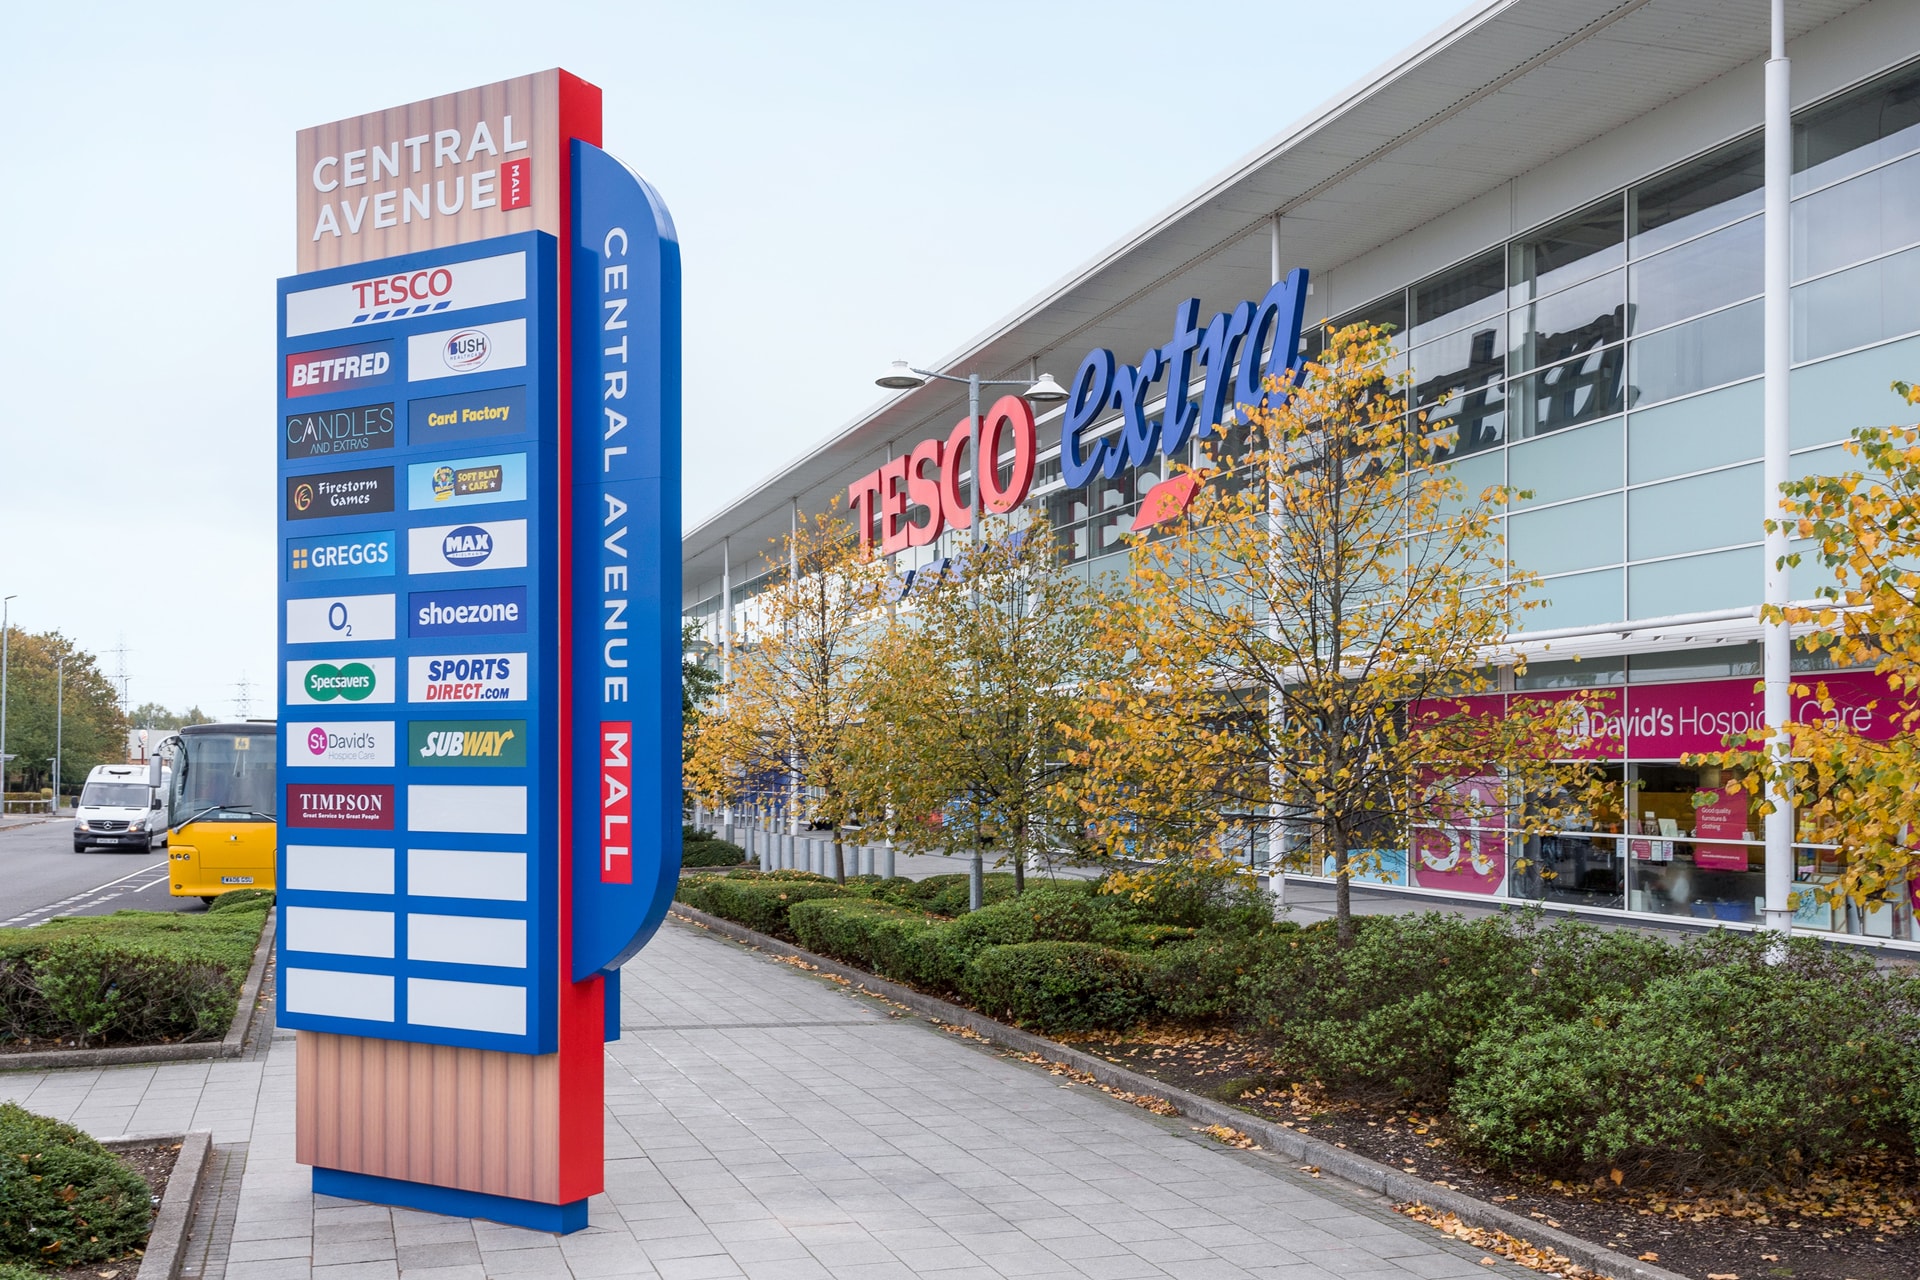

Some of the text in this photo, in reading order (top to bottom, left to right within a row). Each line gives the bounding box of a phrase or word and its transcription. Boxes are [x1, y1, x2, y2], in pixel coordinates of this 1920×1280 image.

[312, 115, 528, 193] CENTRAL
[511, 165, 521, 206] MALL
[312, 170, 496, 241] AVENUE
[352, 268, 453, 309] TESCO
[450, 337, 485, 355] BUSH
[292, 351, 390, 387] BETFRED
[287, 407, 394, 444] CANDLES
[428, 405, 510, 427] Card Factory
[848, 267, 1309, 564] TESCO extra
[310, 437, 369, 454] AND EXTRAS
[457, 468, 499, 483] SOFT PLAY
[468, 480, 489, 491] CAFE
[318, 480, 378, 495] Firestorm
[330, 494, 370, 507] Games
[311, 542, 389, 568] GREGGS
[446, 534, 489, 553] MAX
[604, 226, 629, 872] CENTRAL AVENUE MALL
[418, 602, 519, 626] shoezone
[428, 658, 511, 682] SPORTS
[310, 674, 370, 692] Specsavers
[1590, 707, 1674, 739] David's
[1679, 702, 1768, 738] Hospic
[310, 732, 375, 749] St David's
[420, 729, 515, 758] SUBWAY
[328, 751, 375, 761] Hospice Care
[299, 793, 383, 811] TIMPSON
[361, 813, 380, 821] People
